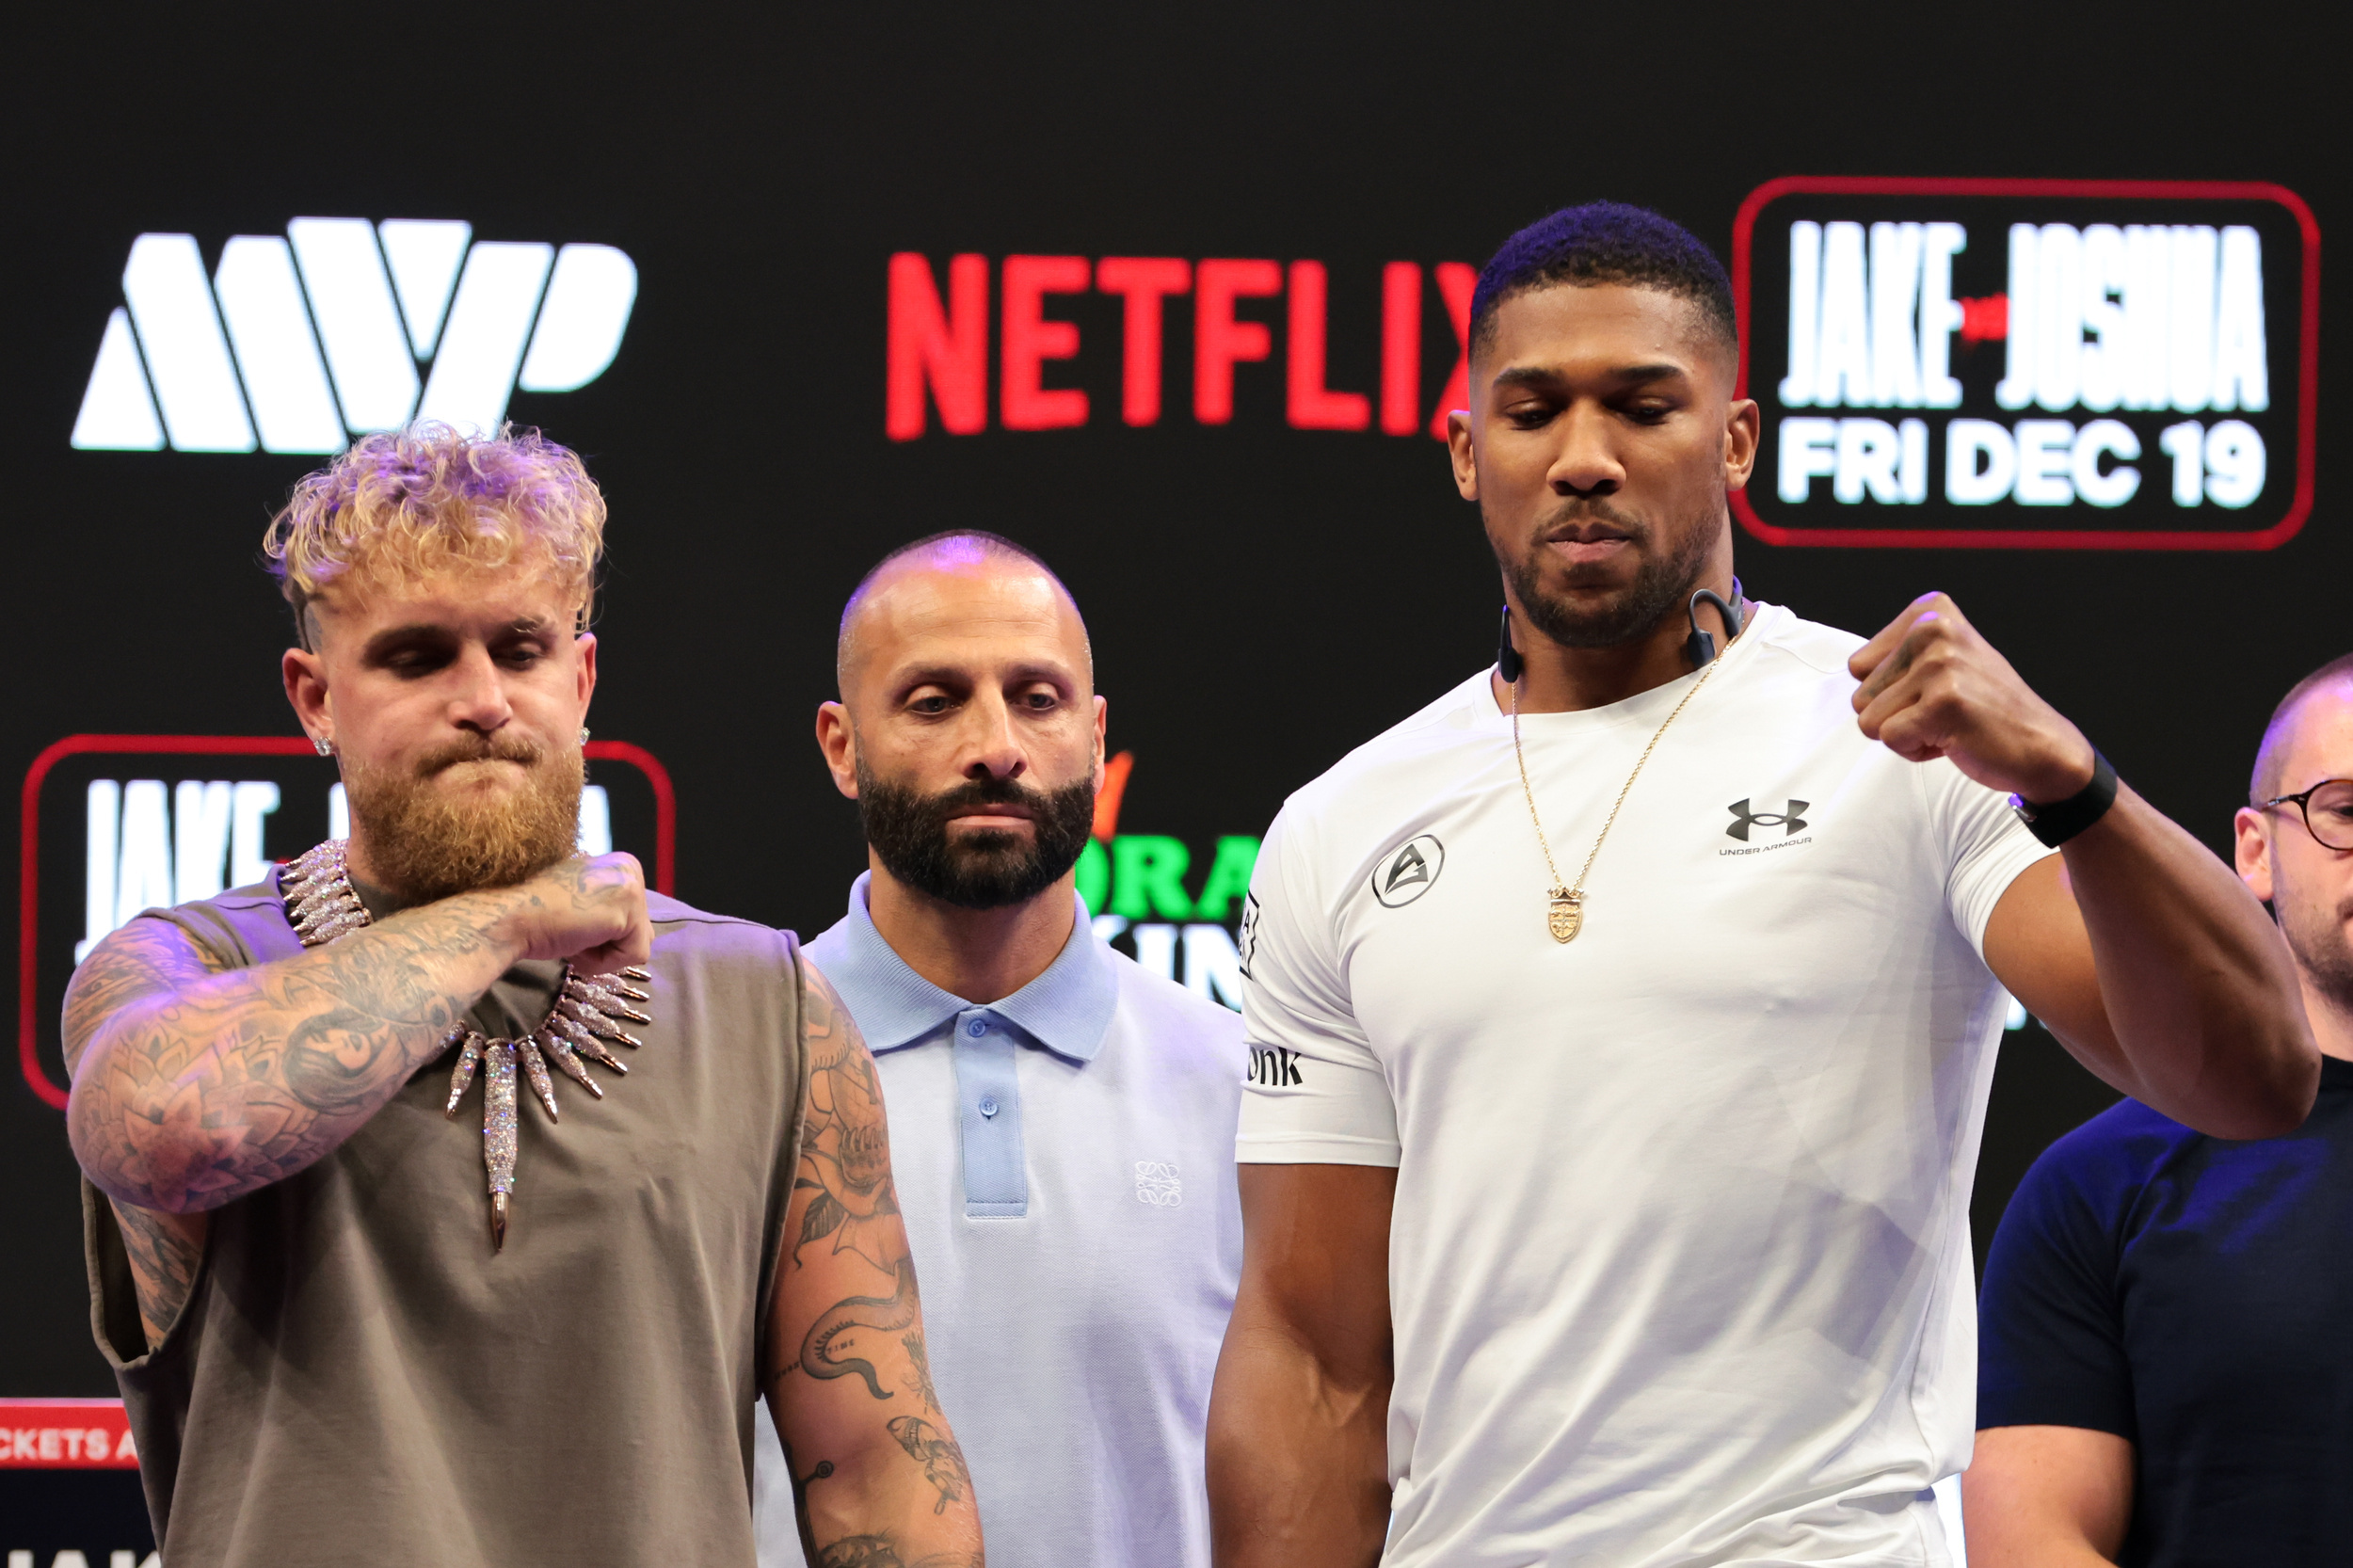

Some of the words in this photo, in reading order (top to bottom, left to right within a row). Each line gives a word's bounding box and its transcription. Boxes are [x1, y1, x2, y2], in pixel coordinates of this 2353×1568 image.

[71, 216, 638, 455] MVP
[1778, 220, 1966, 408] JAKE
[1994, 222, 2268, 412] JOSHUA
[1777, 416, 1929, 504] FRI
[1945, 418, 2141, 507] DEC
[2159, 419, 2267, 508] 19
[1719, 847, 1761, 856] UNDER
[1762, 836, 1813, 853] ARMOUR
